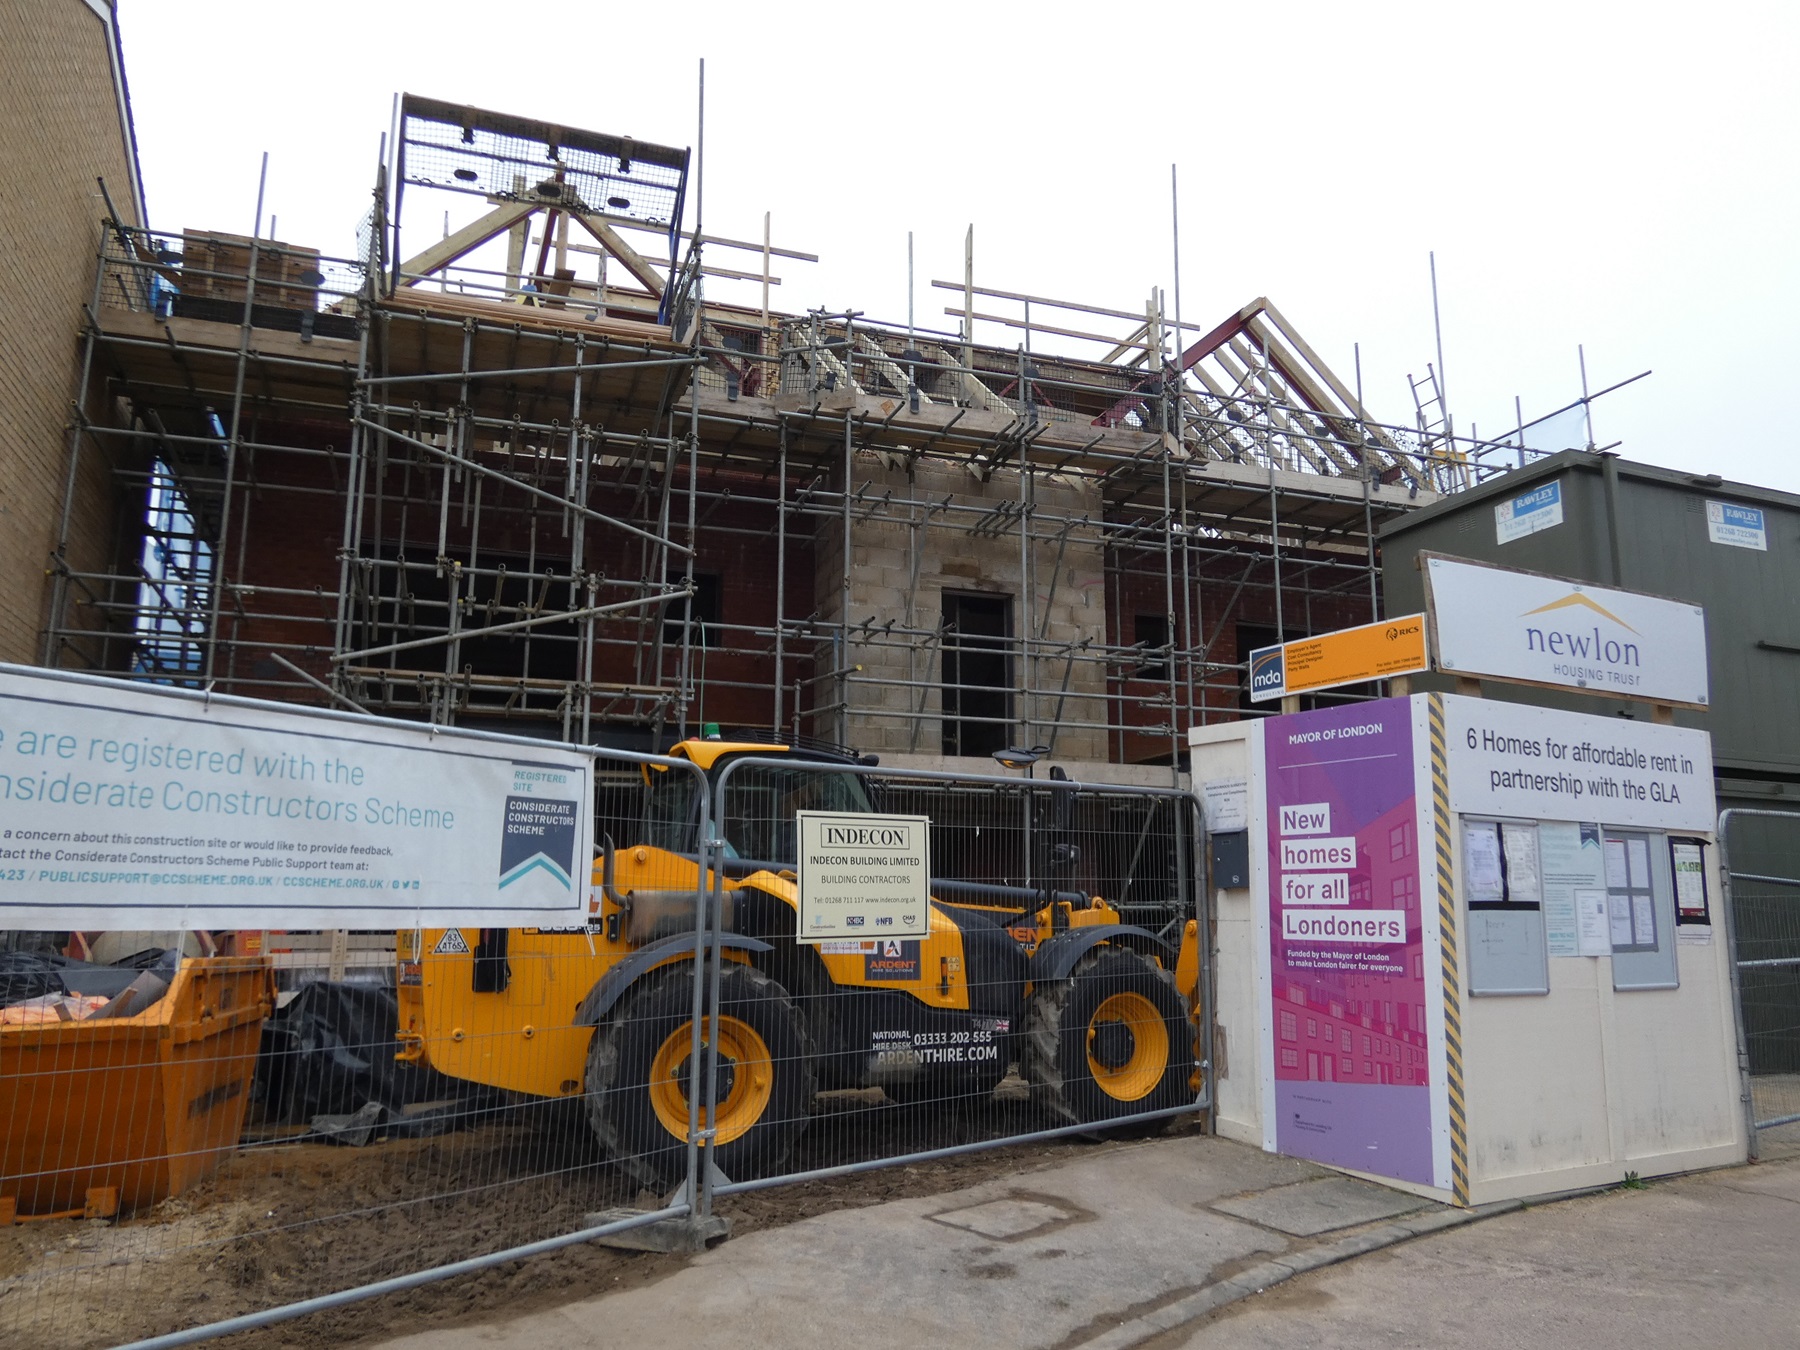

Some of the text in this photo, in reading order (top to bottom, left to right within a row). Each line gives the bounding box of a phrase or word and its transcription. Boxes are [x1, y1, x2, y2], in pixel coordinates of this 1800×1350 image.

[1516, 487, 1554, 508] RAWLEY
[1726, 509, 1758, 522] RAWLEY
[1399, 626, 1419, 636] RICS
[1526, 628, 1640, 666] newlon
[1254, 670, 1280, 688] mda
[1554, 664, 1640, 686] HOUSING TRUST
[1289, 724, 1382, 745] MAYOR OF LONDON
[16, 731, 77, 758] are
[88, 737, 245, 776] registered
[254, 752, 315, 781] with
[324, 758, 364, 786] the
[1467, 728, 1694, 774] 6 Homes for affordable rent in
[514, 770, 568, 784] REGISTERED
[1490, 768, 1681, 804] partnership with the GLA
[513, 782, 533, 792] SITE
[0, 771, 455, 830] nsiderate Constructors Scheme
[510, 801, 570, 814] CONSIDERATE
[508, 812, 574, 826] CONSTRUCTORS
[1284, 810, 1325, 830] New
[508, 824, 545, 836] SCHEME
[827, 828, 904, 846] INDECON
[3, 829, 394, 856] a concern about this construction site or would like to provide feedback,
[29, 848, 52, 861] the
[54, 850, 128, 864] Considerate
[130, 852, 204, 866] Constructors
[206, 855, 250, 868] Scheme
[252, 857, 284, 869] Public
[286, 858, 328, 872] Support
[330, 860, 354, 871] team
[356, 862, 369, 872] at:
[810, 856, 920, 866] INDECON BUILDING LIMITED
[1284, 846, 1352, 864] homes
[38, 870, 273, 887] PUBLICSUPPORT@CCSCHEME.ORG.UK
[283, 877, 384, 890] CCSCHEME.ORG.UK
[821, 875, 910, 884] BUILDING CONTRACTORS
[1286, 879, 1345, 900] for all
[865, 897, 916, 905] www.indecon.org.uk
[880, 917, 892, 926] NFB
[1286, 914, 1400, 938] Londoners
[448, 934, 458, 942] 83
[1288, 950, 1310, 958] Funded
[1312, 950, 1319, 959] by
[1332, 952, 1352, 960] Mayor
[1370, 964, 1404, 973] everyone
[872, 1030, 911, 1040] NATIONAL
[914, 1031, 992, 1045] 03333 202 555
[872, 1042, 912, 1050] HIRE DESK
[878, 1046, 998, 1066] ARDENTHIRE.COM
